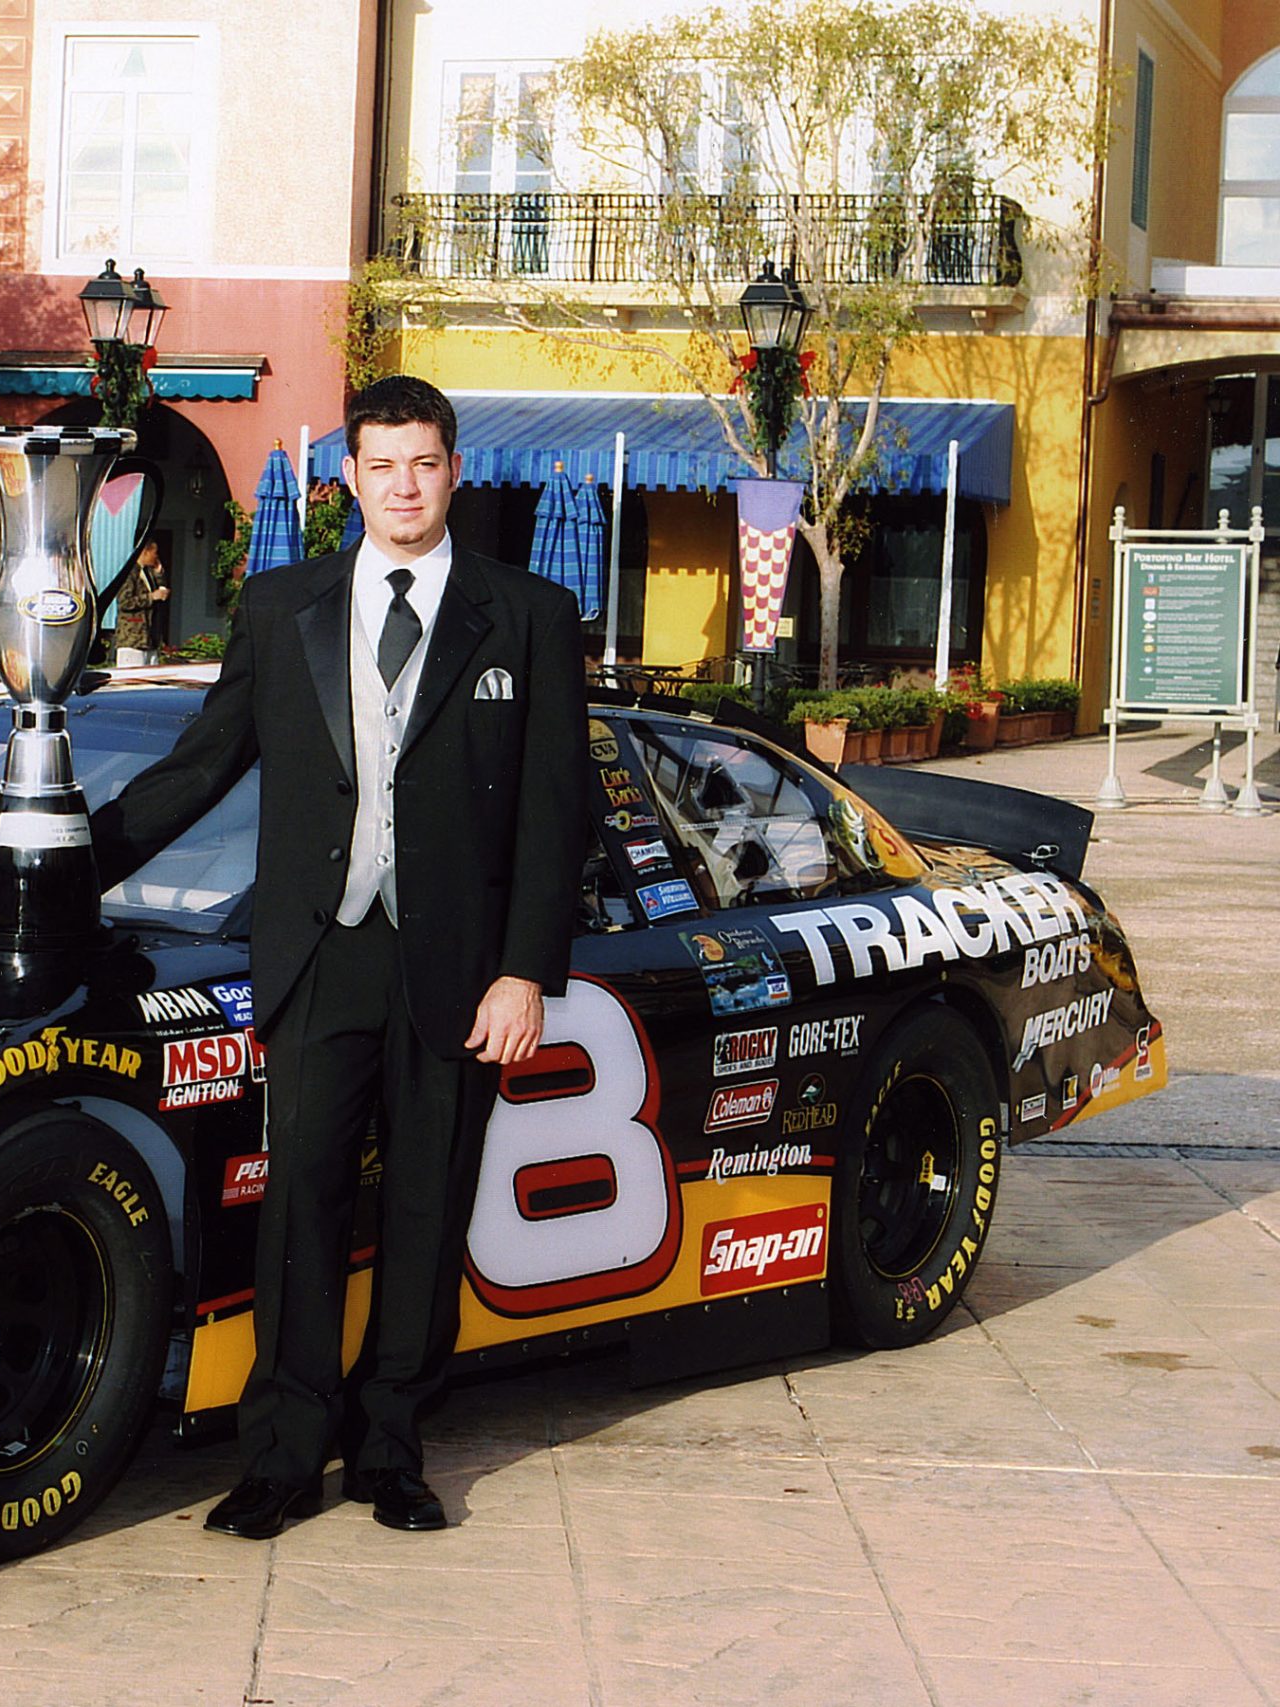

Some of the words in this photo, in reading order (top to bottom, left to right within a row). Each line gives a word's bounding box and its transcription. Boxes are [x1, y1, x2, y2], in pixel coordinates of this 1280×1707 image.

[1133, 552, 1183, 563] PORTOFINO
[1185, 553, 1203, 563] BAY
[1205, 553, 1235, 564] HOTEL
[591, 743, 617, 757] CVA
[600, 767, 632, 787] Uncle
[770, 872, 1088, 986] TRACKER
[1021, 933, 1091, 989] BOATS
[137, 987, 220, 1023] MBNA
[1013, 988, 1115, 1062] MERCURY
[731, 1029, 777, 1062] ROCKY
[788, 1015, 861, 1058] GORE-TEX
[167, 1036, 243, 1086] MSD
[166, 1079, 240, 1108] IGNITION
[712, 1091, 761, 1120] Coleman
[464, 975, 675, 1304] 8
[705, 1143, 812, 1185] Remington
[87, 1162, 149, 1227] EAGLE
[704, 1225, 824, 1277] Snap-on
